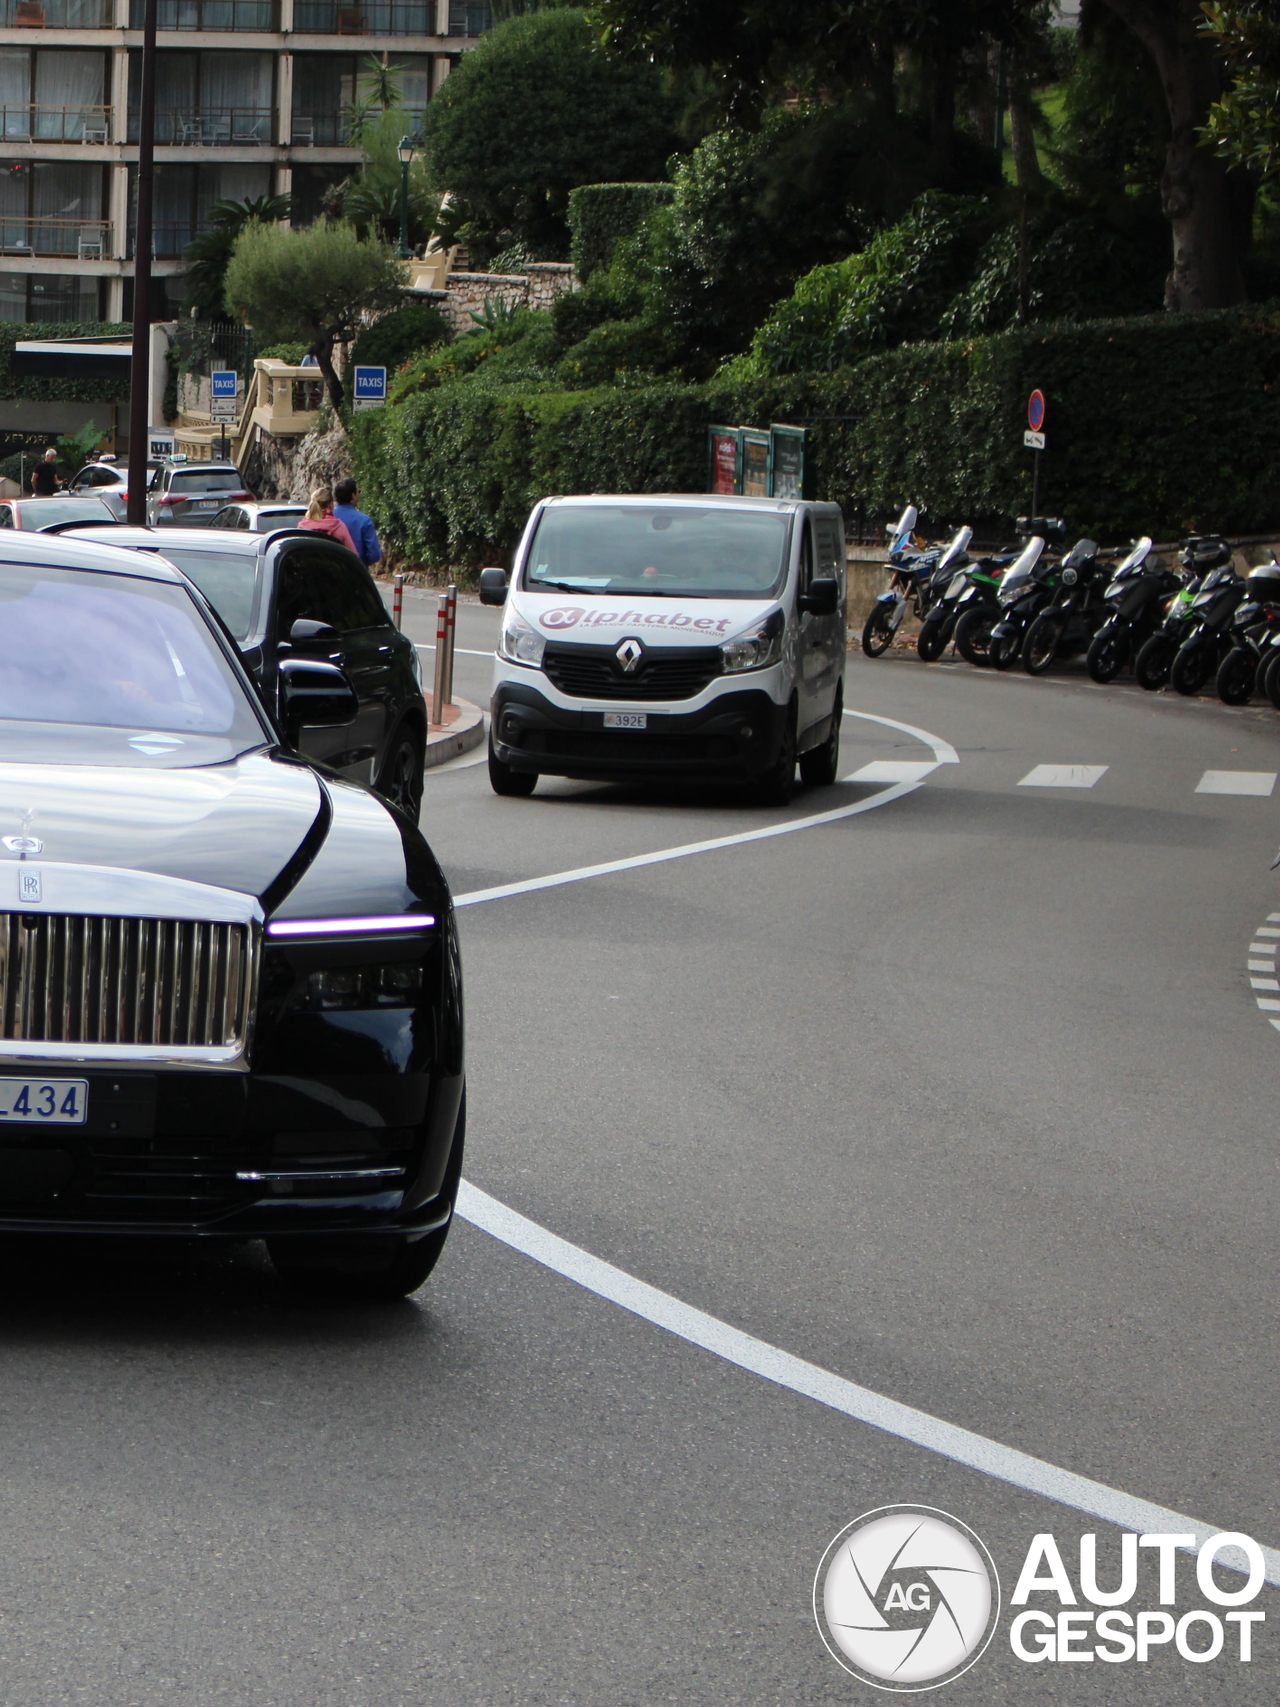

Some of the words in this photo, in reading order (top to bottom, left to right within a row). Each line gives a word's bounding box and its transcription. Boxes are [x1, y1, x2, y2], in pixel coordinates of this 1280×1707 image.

[214, 380, 234, 389] TAXIS
[358, 377, 383, 388] TAXIS
[615, 715, 645, 727] 392E
